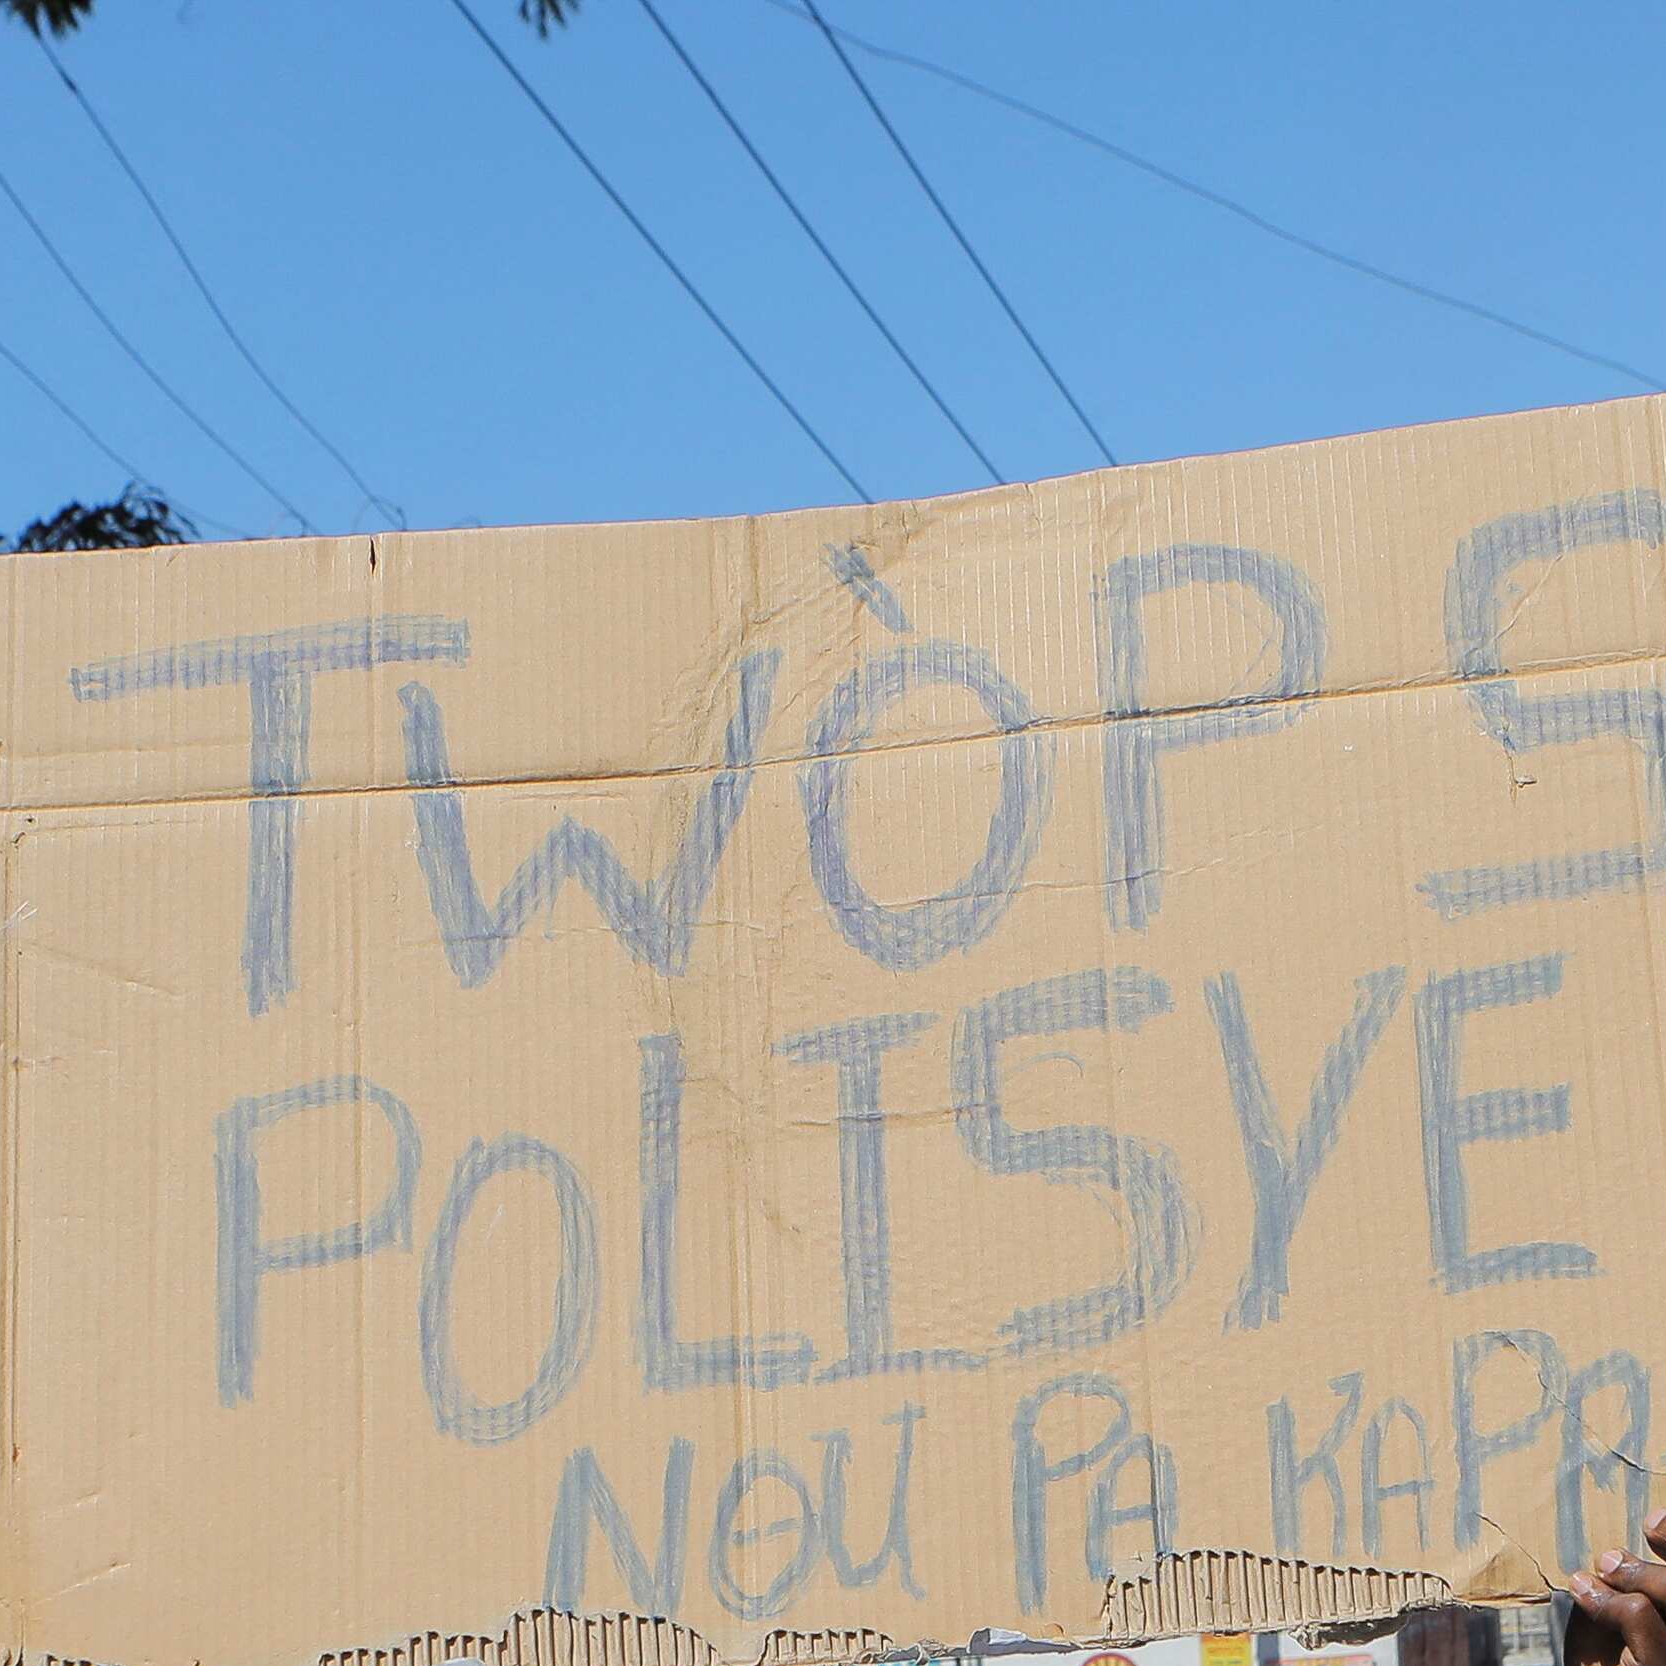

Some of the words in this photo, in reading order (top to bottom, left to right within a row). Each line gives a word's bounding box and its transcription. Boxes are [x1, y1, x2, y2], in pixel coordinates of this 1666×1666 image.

[70, 540, 1329, 1015] TWÒP
[215, 951, 1605, 1446] POLISYE
[544, 1404, 925, 1619] NOU
[1012, 1372, 1177, 1615] PA
